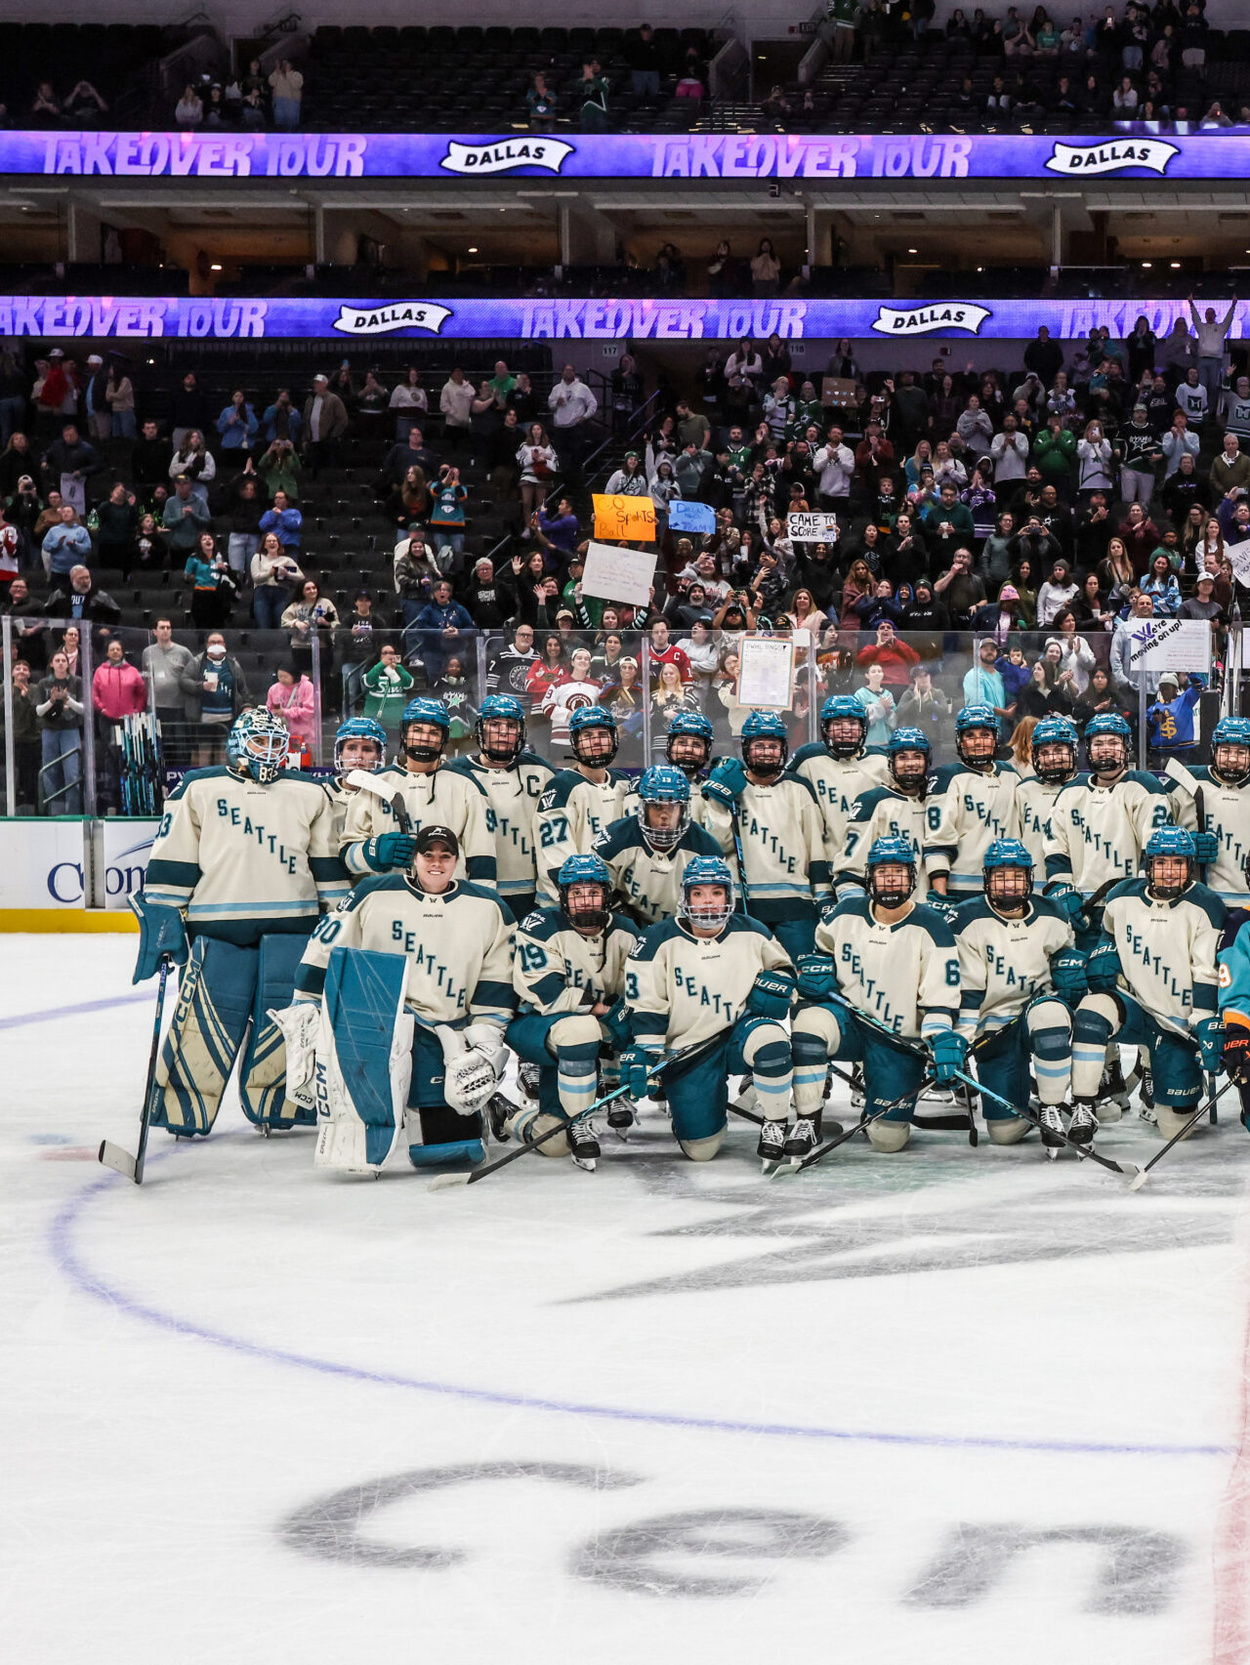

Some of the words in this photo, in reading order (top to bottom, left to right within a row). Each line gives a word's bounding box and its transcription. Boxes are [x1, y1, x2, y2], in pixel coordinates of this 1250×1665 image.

[43, 132, 251, 176] TAKEOVER
[261, 134, 367, 177] TOUR
[464, 145, 546, 168] DALLAS
[651, 134, 860, 177] TAKEOVER
[870, 135, 974, 177] TOUR
[1068, 146, 1151, 169] DALLAS
[0, 297, 166, 337] AKEOVER
[176, 299, 268, 337] TOUR
[353, 308, 428, 330] DALLAS
[519, 299, 705, 338] TAKEOVER
[715, 300, 807, 338] TOUR
[892, 308, 967, 330] DALLAS
[790, 514, 821, 527] CAME
[790, 525, 819, 537] SCORE
[1157, 630, 1170, 641] on
[673, 651, 681, 662] C
[258, 767, 274, 782] 83
[526, 775, 541, 798] C
[928, 806, 942, 830] 8
[964, 794, 1007, 839] SEATT
[217, 798, 298, 875] SEATTLE
[539, 817, 569, 849] 27
[736, 803, 796, 874] SEATTLE
[1071, 808, 1134, 877] SEATTLE
[1204, 813, 1248, 872] EATTL
[47, 862, 147, 903] Com
[624, 867, 671, 920] SEATT
[311, 919, 343, 945] 30
[392, 920, 468, 1009] SEATTLE
[519, 942, 550, 973] 19
[1089, 945, 1118, 959] BAU
[1126, 924, 1192, 1007] SEATTLE
[801, 964, 834, 973] CCM
[945, 959, 960, 987] 6
[987, 945, 1037, 996] SEATT
[175, 959, 201, 1023] CCM
[674, 967, 734, 1022] SEATT
[842, 943, 905, 1030] SEATTLE
[1224, 1038, 1250, 1051] UER
[315, 1062, 331, 1119] CCM
[873, 1097, 913, 1110] BAER
